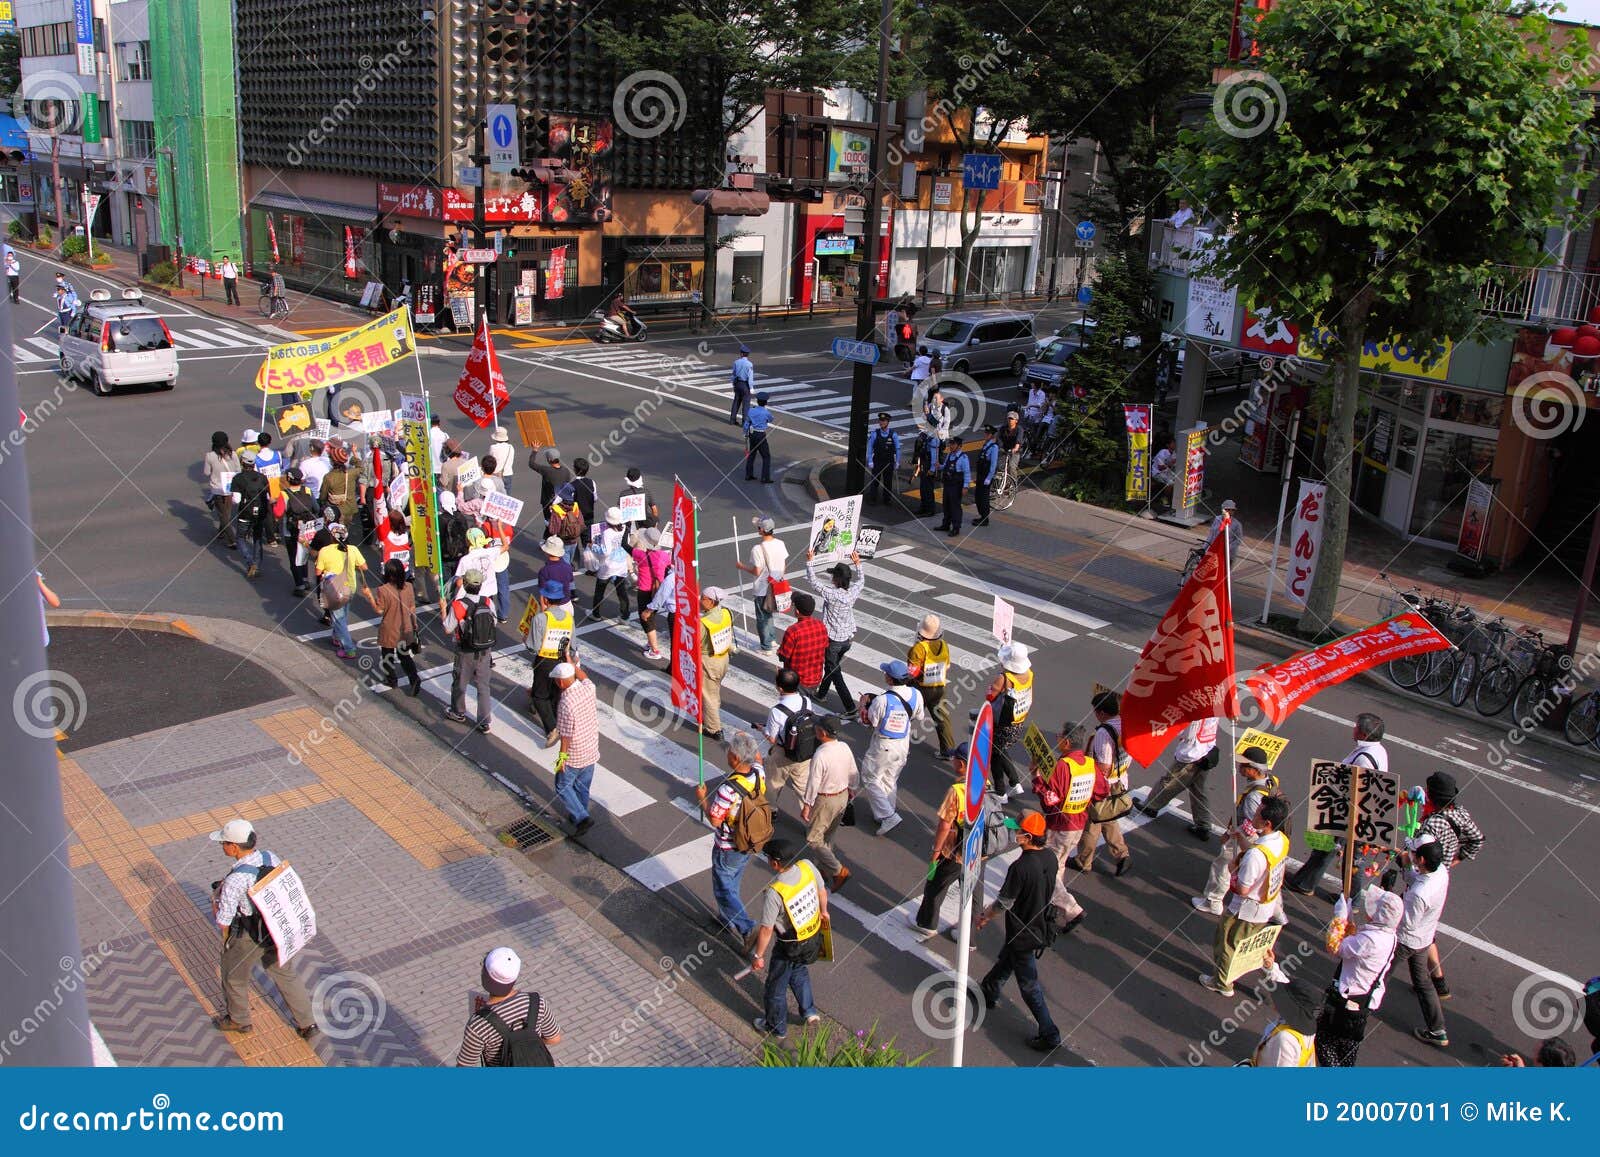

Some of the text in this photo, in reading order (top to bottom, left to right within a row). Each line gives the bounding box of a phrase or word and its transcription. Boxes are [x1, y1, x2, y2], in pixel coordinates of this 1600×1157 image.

[401, 189, 435, 217] はなの舞
[1291, 491, 1324, 598] だんご
